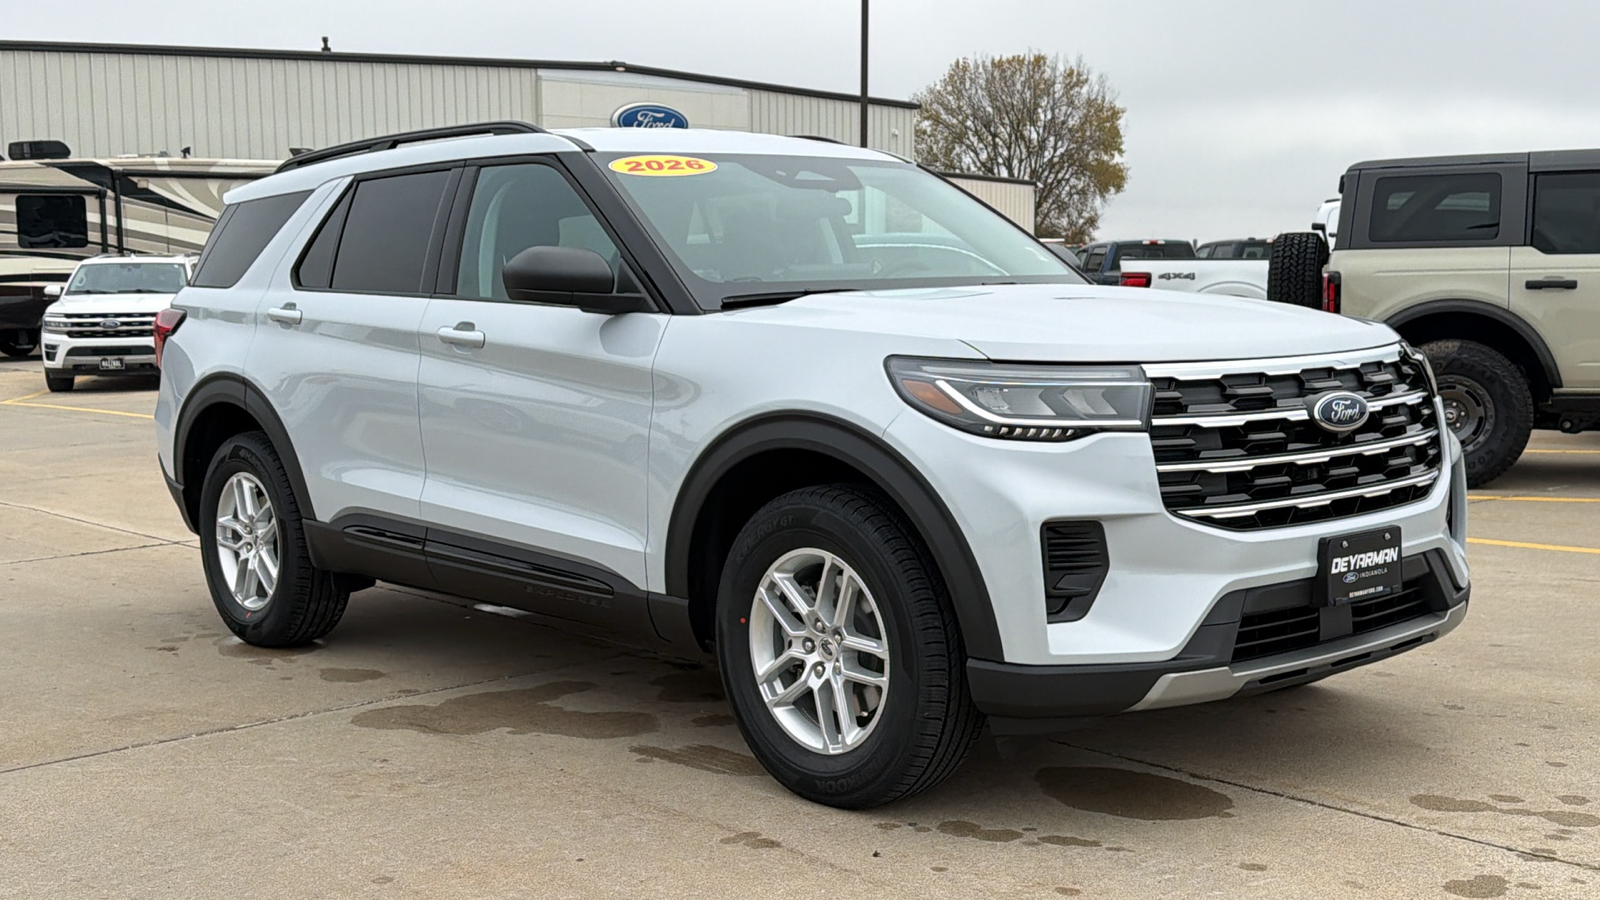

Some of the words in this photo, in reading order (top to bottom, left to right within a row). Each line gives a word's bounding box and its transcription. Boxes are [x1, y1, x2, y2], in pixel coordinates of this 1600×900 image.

[624, 159, 705, 172] 2026
[1331, 400, 1360, 422] Ford
[1331, 547, 1398, 574] DEYARMAN
[1360, 567, 1388, 578] INDIANOLA
